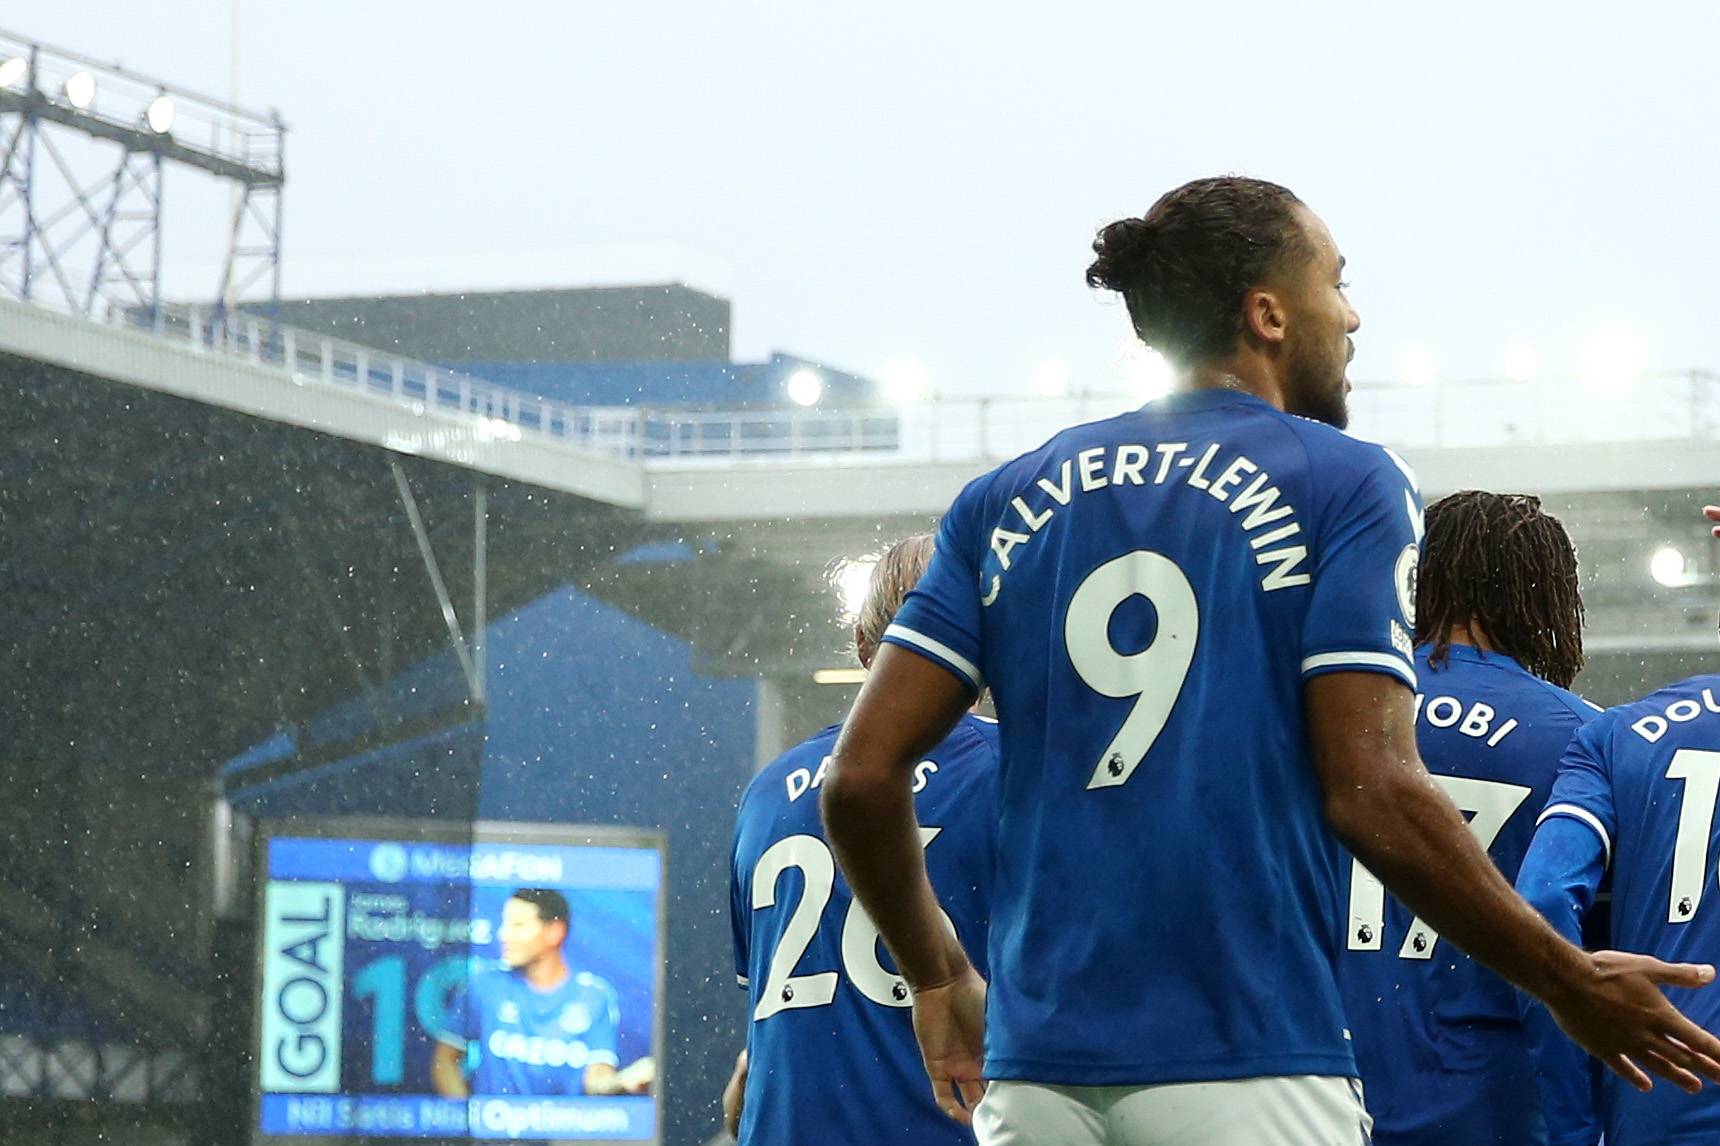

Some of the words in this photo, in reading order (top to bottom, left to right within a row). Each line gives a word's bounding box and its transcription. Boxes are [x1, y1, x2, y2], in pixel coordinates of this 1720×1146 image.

[1064, 549, 1199, 790] 9
[1413, 693, 1519, 747] OBI
[276, 895, 331, 1079] GOAL
